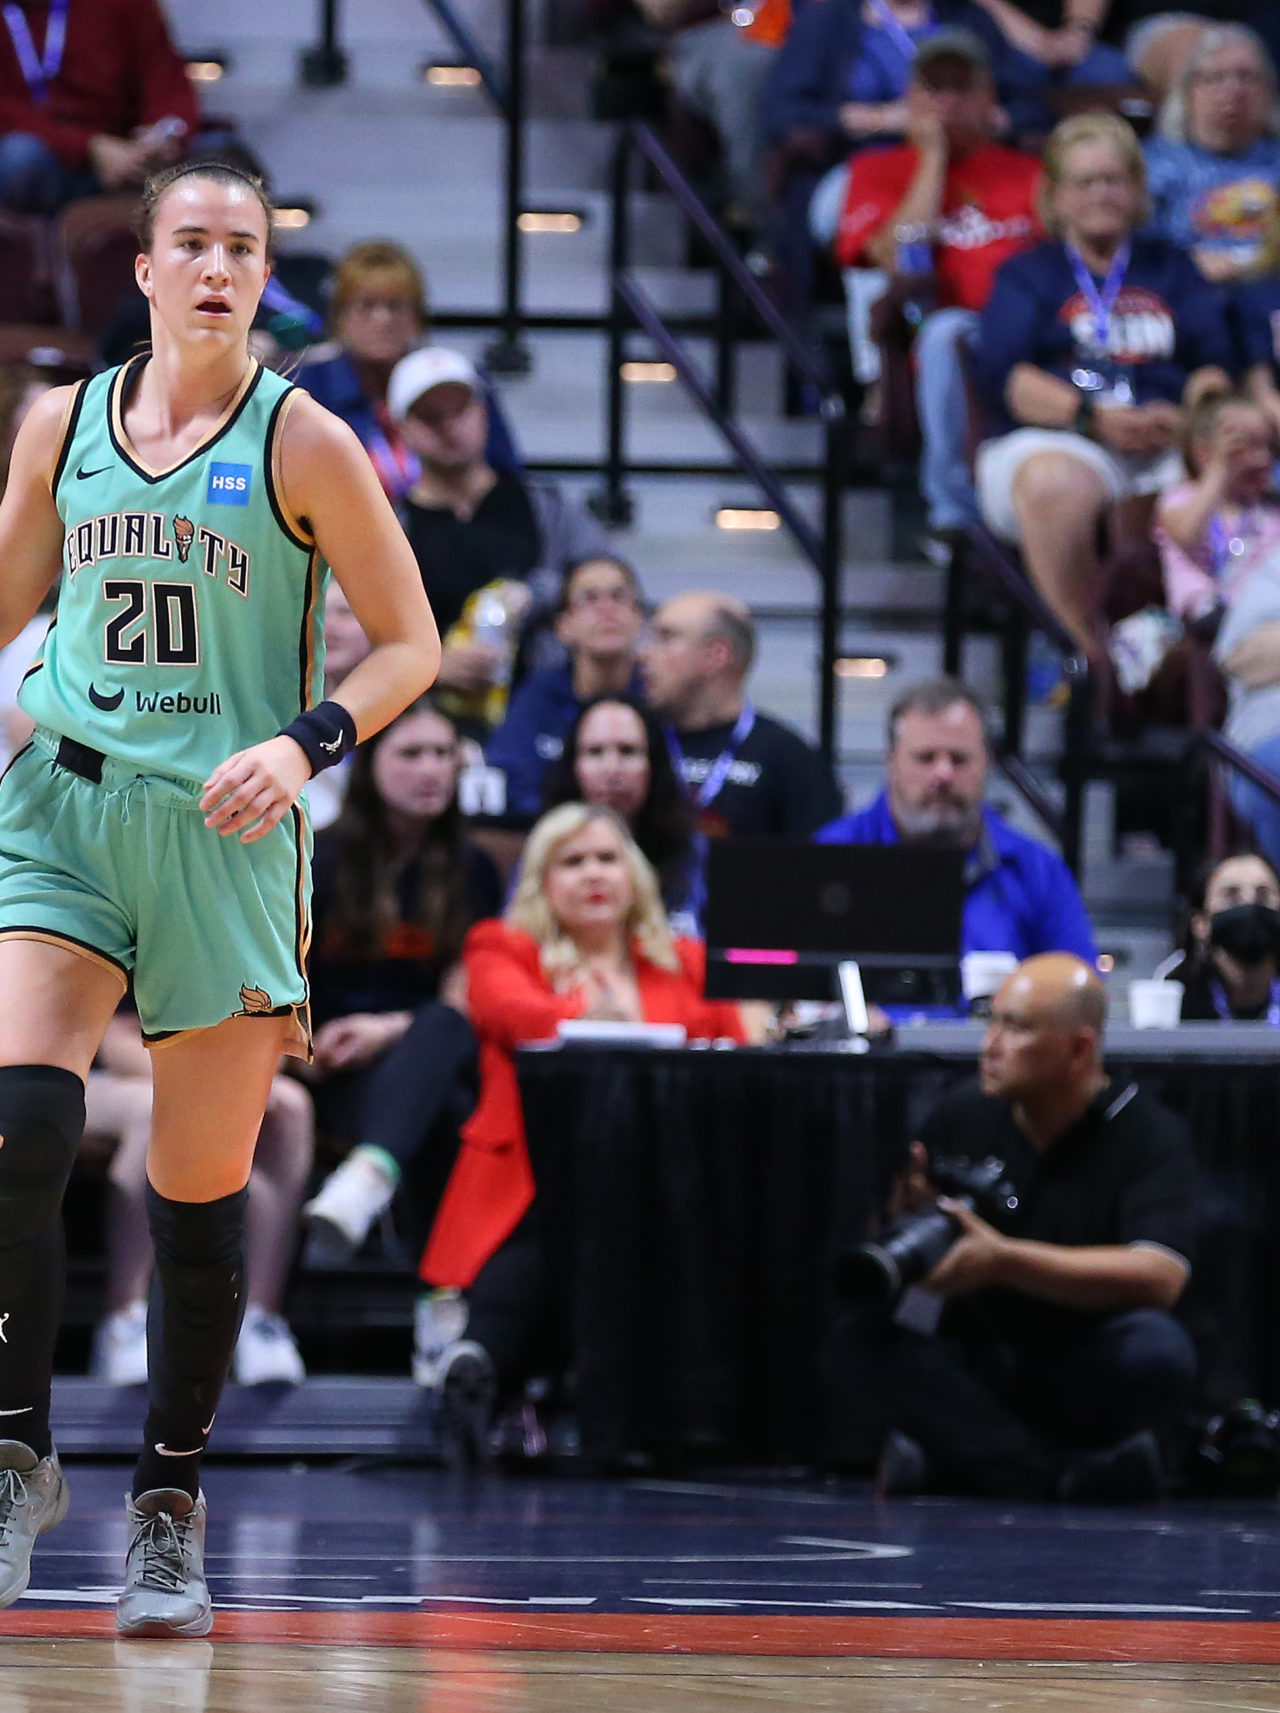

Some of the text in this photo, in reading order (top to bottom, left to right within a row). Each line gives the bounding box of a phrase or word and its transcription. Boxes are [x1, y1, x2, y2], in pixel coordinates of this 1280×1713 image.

[212, 475, 247, 491] HSS
[103, 579, 201, 667] 20
[136, 691, 222, 715] Webull
